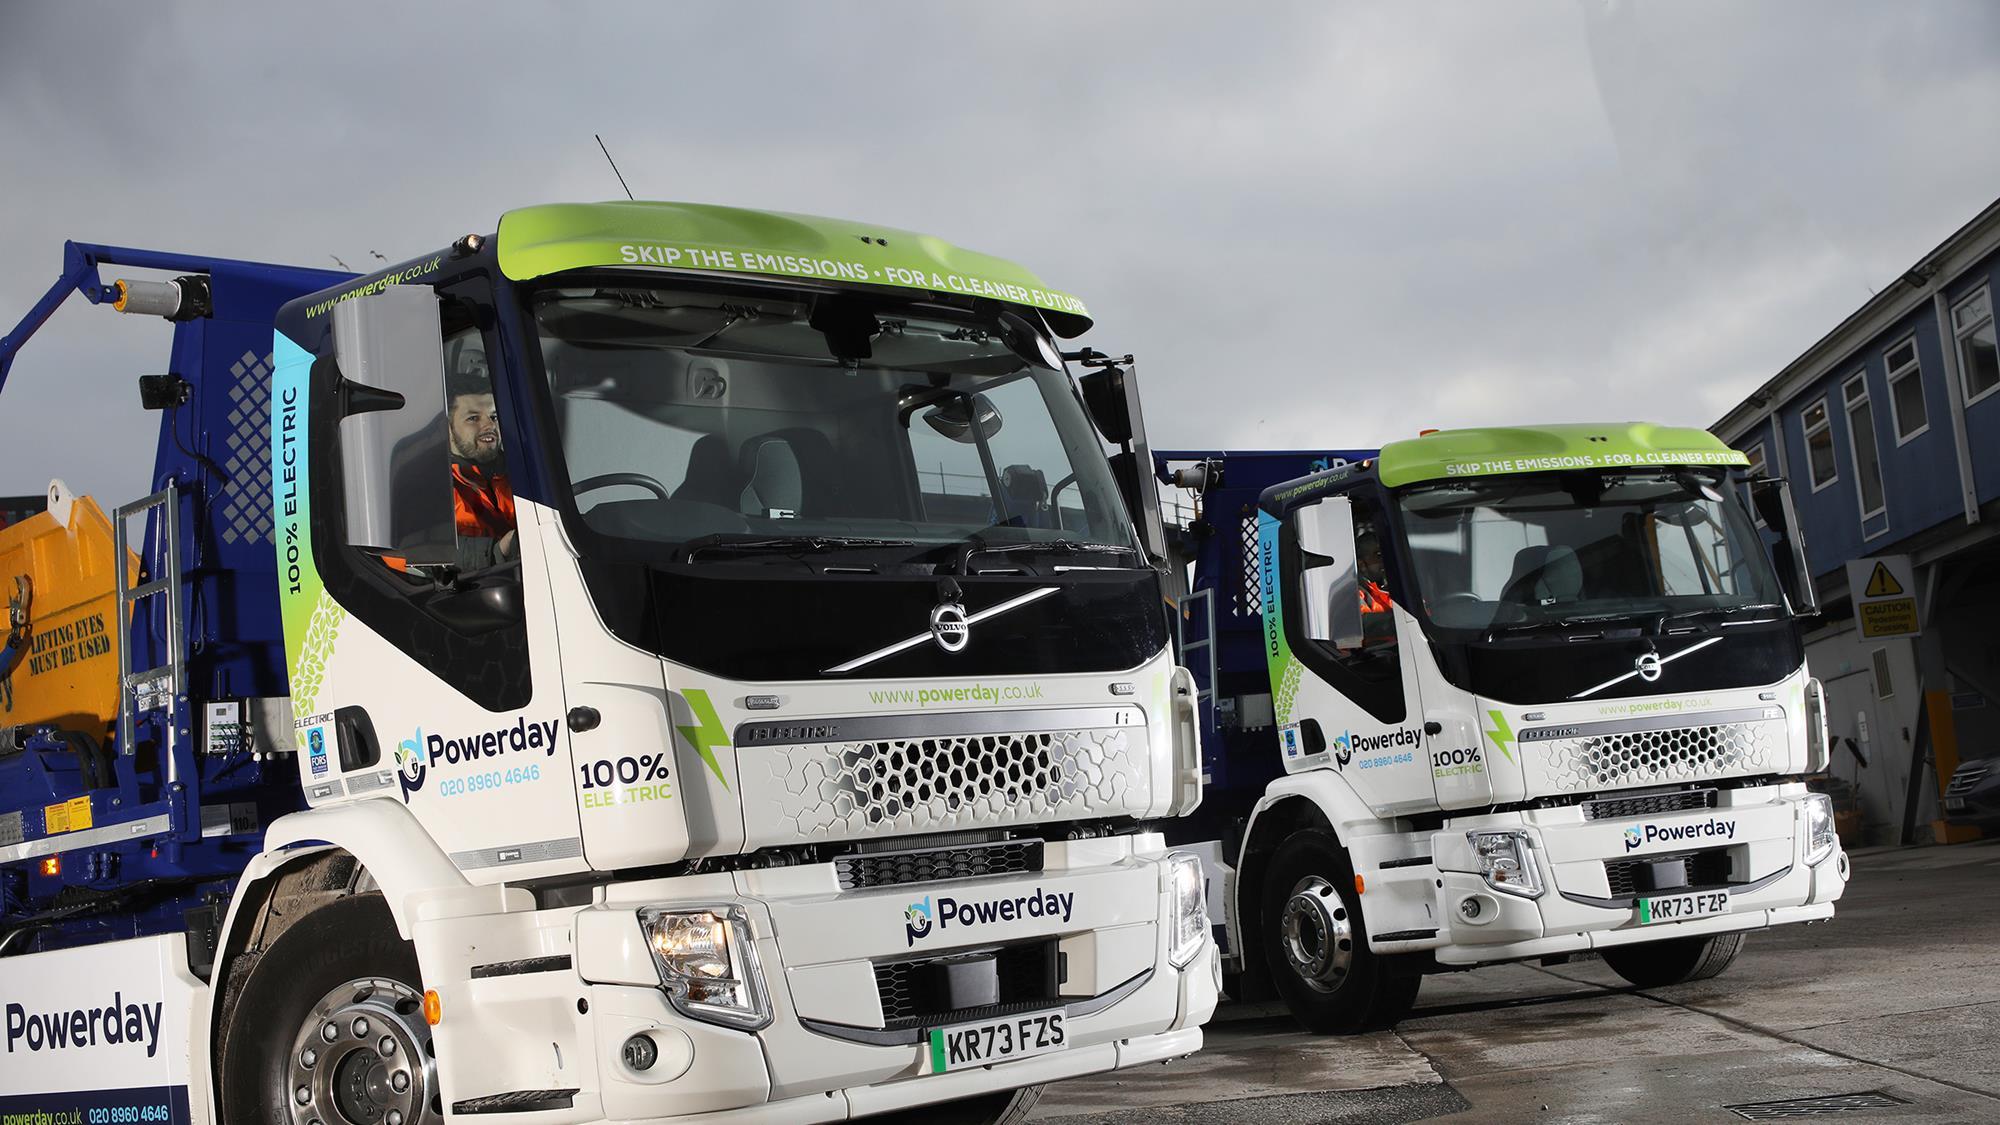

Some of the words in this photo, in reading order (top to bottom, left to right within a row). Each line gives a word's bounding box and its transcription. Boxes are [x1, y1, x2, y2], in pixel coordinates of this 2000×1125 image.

[305, 256, 441, 319] wwwowerday.co.uk
[620, 245, 681, 265] SKIP
[684, 248, 736, 268] THE
[740, 252, 868, 280] EMISSIONS
[885, 267, 927, 288] FOR
[932, 273, 947, 288] A
[948, 275, 1030, 303] CLEANER
[282, 386, 298, 517] ELECTRIC
[1446, 463, 1480, 475] SKIP
[1483, 460, 1513, 472] THE
[1515, 455, 1594, 471] EMISSIONS
[1604, 453, 1633, 465] FOR
[1636, 453, 1645, 464] A
[1647, 452, 1704, 463] CLEANER
[285, 522, 301, 595] 100%
[1264, 540, 1275, 614] ELECTRIC
[1865, 602, 1911, 615] CAUTION
[31, 623, 74, 655] LIFTING
[75, 613, 104, 639] EYES
[934, 623, 967, 631] VOLVO
[1267, 617, 1279, 658] 100%
[29, 650, 58, 676] MUST
[61, 644, 77, 666] BE
[78, 634, 110, 660] USED
[869, 682, 1044, 708] www.powerday.co.uk
[1599, 697, 1713, 715] www.powerday.co.uk
[294, 712, 334, 728] ELECTRIC
[427, 716, 559, 768] Powerday
[1351, 727, 1421, 753] Powerday
[311, 755, 327, 767] FORS
[580, 753, 669, 790] 100%
[1432, 747, 1481, 767] 100%
[1434, 763, 1483, 778] ELECTRIC
[439, 776, 465, 797] 020
[467, 771, 503, 793] 8960
[504, 764, 540, 786] 4646
[583, 783, 673, 809] ELECTRIC
[1645, 818, 1736, 844] Powerday
[937, 888, 1074, 929] Powerday
[1651, 897, 1695, 920] KR73
[1697, 893, 1728, 914] FZP
[6, 991, 162, 1058] Powerday
[948, 1023, 1013, 1065] KR73
[1018, 1014, 1065, 1051] FZS
[89, 1108, 110, 1125] 020
[111, 1106, 139, 1123] 8960
[141, 1105, 169, 1122] 4646
